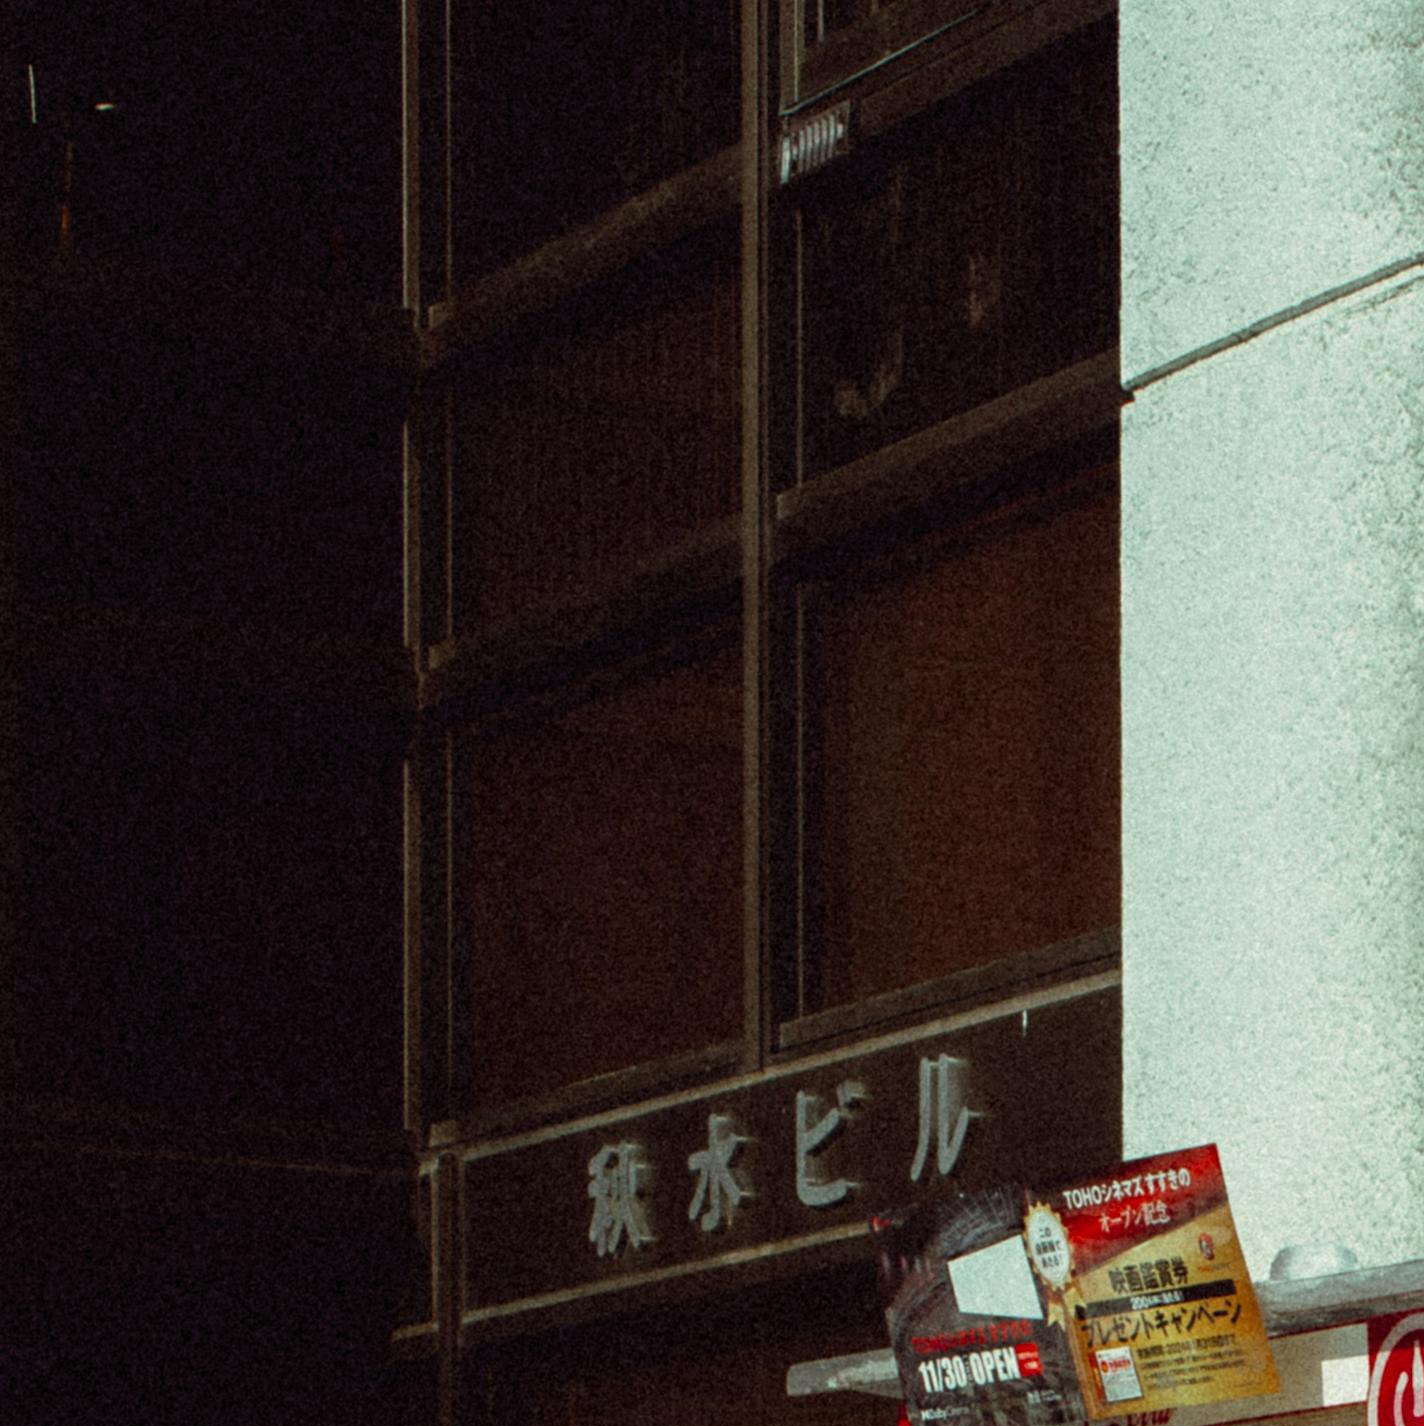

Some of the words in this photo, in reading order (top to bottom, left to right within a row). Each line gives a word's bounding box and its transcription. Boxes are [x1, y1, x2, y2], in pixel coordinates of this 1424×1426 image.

[1081, 1299, 1242, 1348] プレゼントキャンペーン
[918, 1354, 968, 1393] 11/30
[968, 1346, 1021, 1386] OPEN
